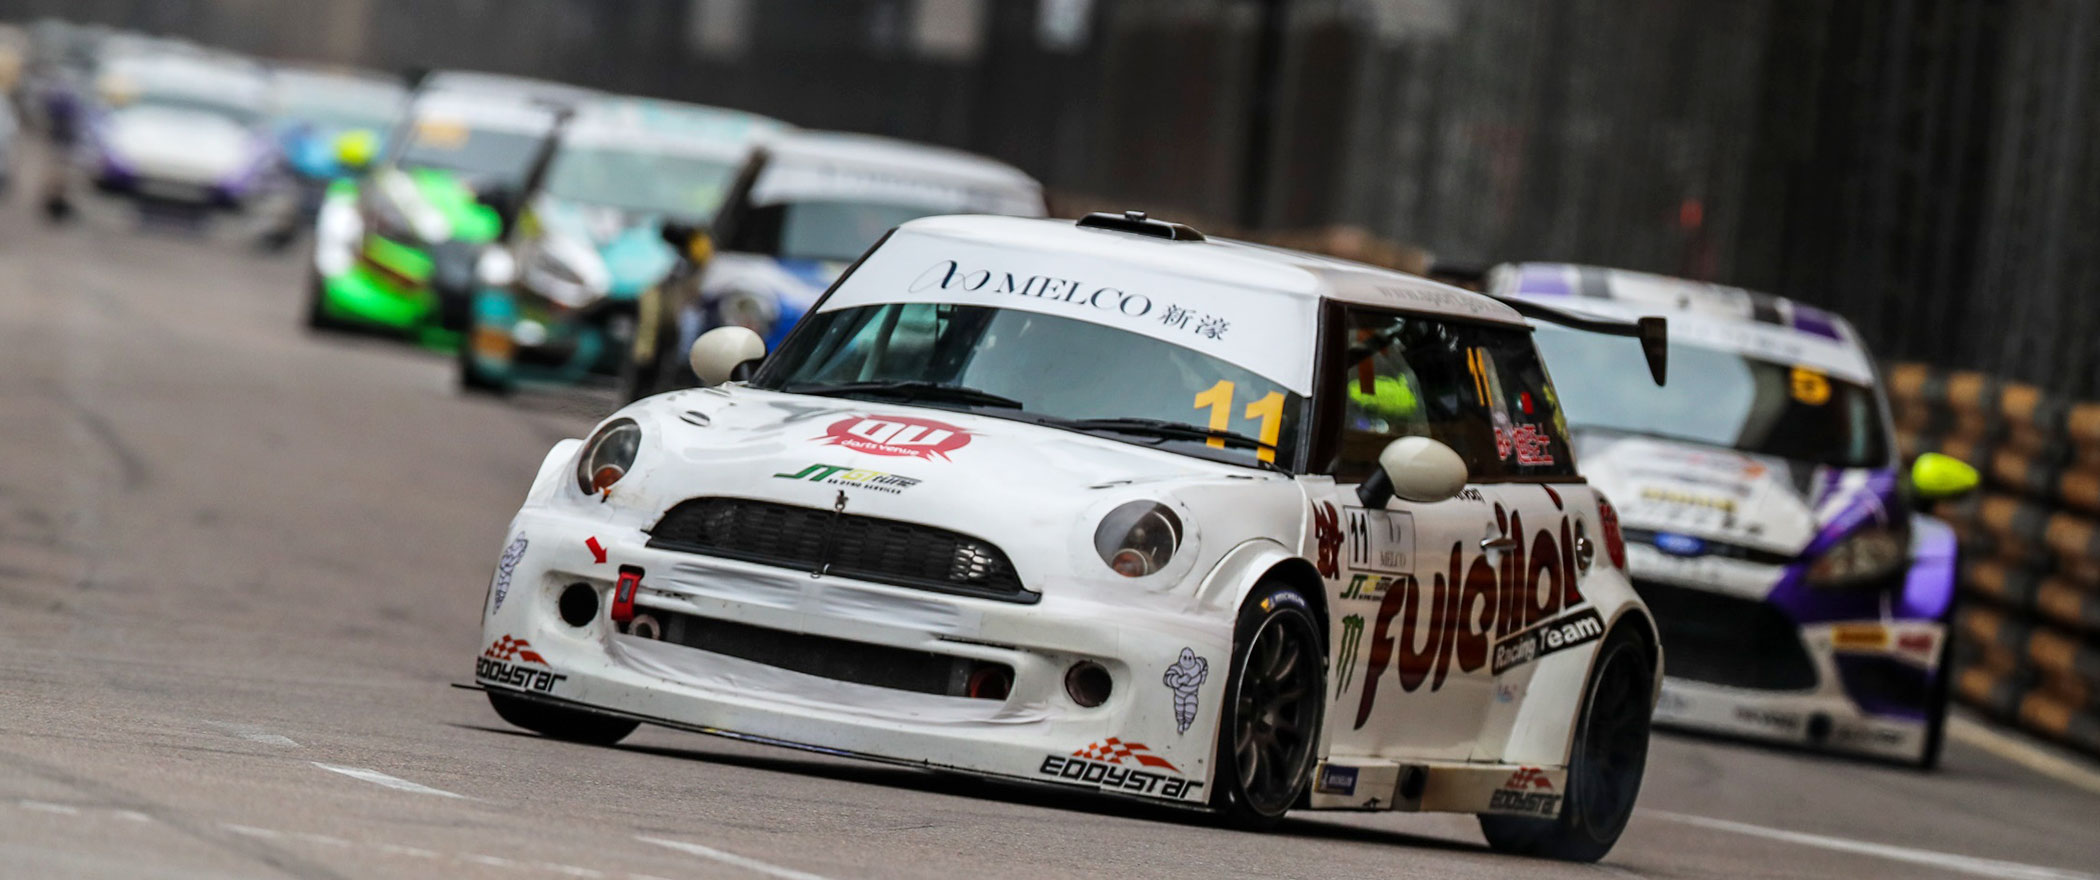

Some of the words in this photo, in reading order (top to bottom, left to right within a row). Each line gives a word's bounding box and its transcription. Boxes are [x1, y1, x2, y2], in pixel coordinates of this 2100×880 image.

[994, 272, 1152, 318] MELCO
[1158, 304, 1232, 341] 新濠
[1194, 379, 1286, 464] 11
[841, 438, 877, 450] darts
[878, 444, 920, 457] venue
[1350, 511, 1369, 564] 11
[1494, 637, 1537, 669] Racing
[1539, 616, 1603, 651] Team
